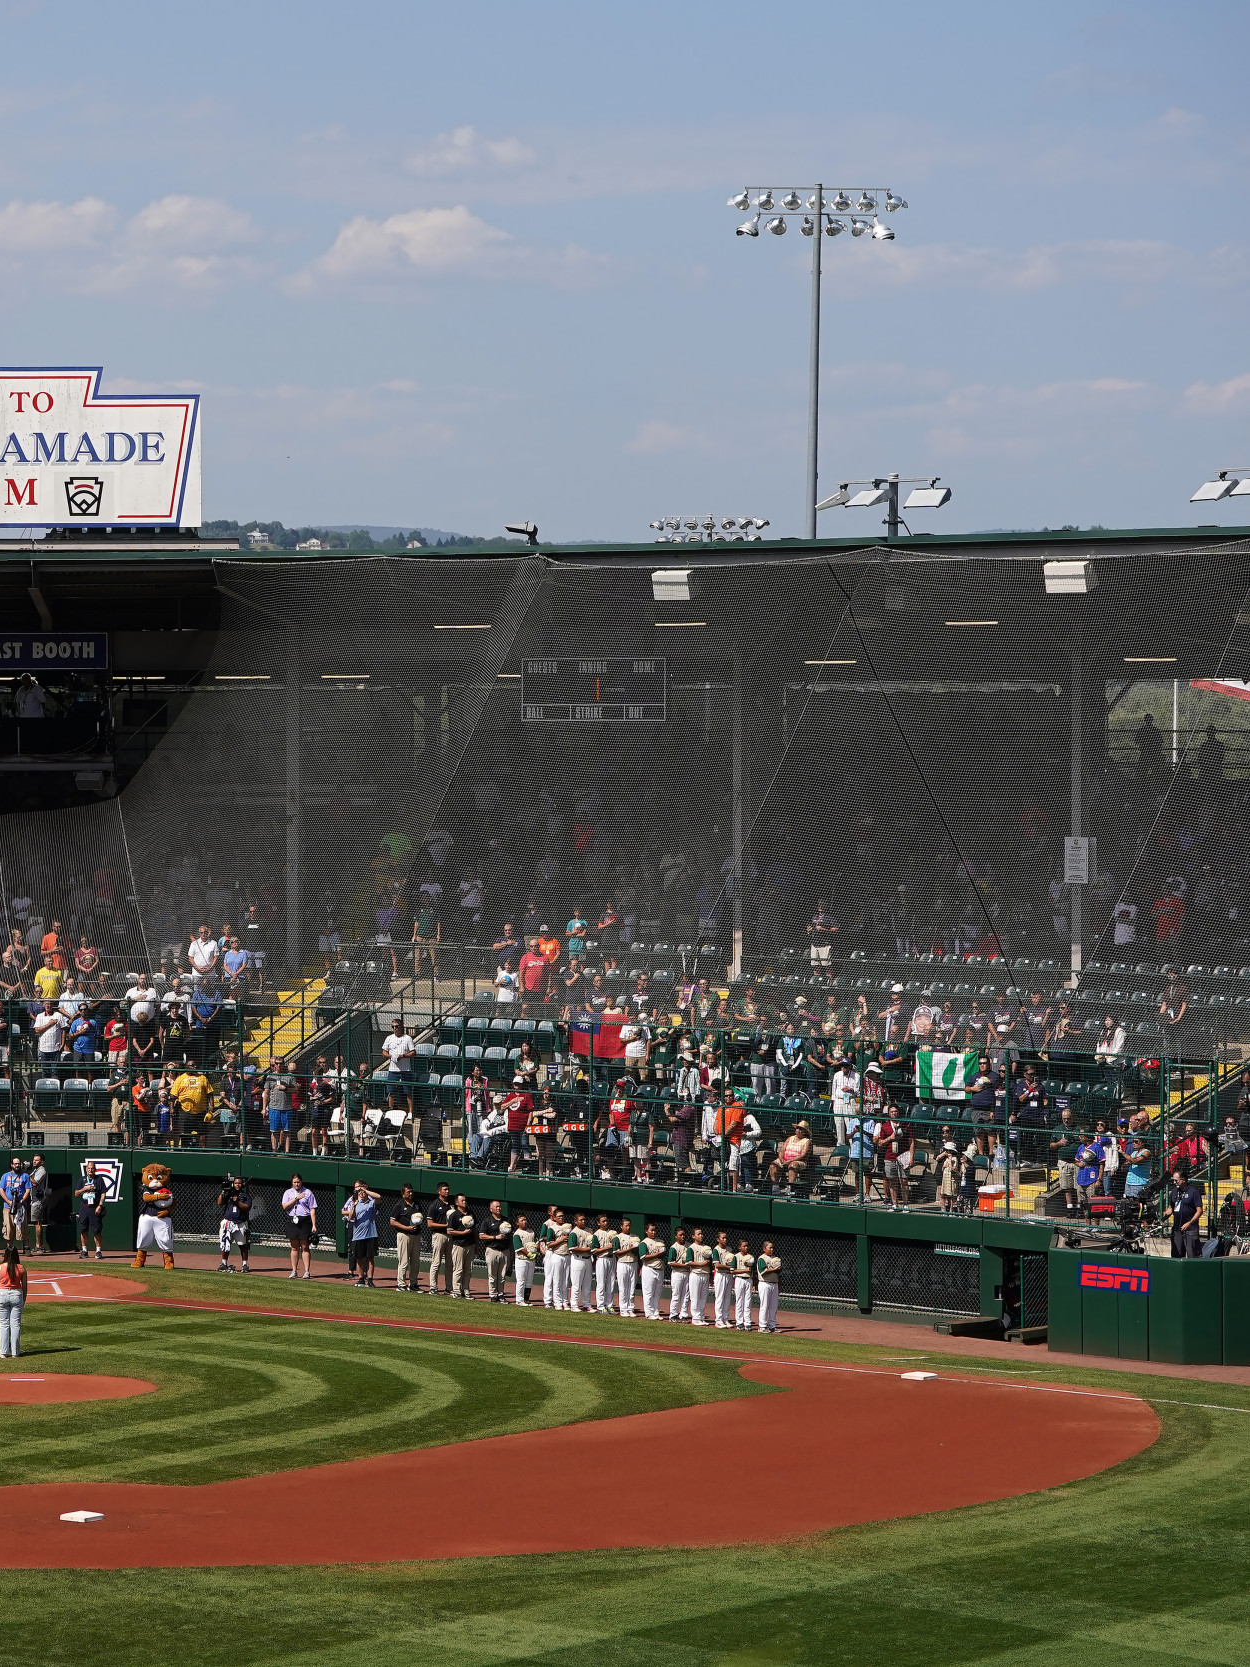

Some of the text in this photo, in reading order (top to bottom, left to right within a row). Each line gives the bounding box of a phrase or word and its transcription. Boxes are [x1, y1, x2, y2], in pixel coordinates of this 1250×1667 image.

[10, 391, 54, 414] TO
[32, 641, 95, 659] BOOTH
[575, 706, 603, 719] STRIKE
[1091, 1205, 1115, 1213] ESPN
[1080, 1264, 1149, 1293] ESPN
